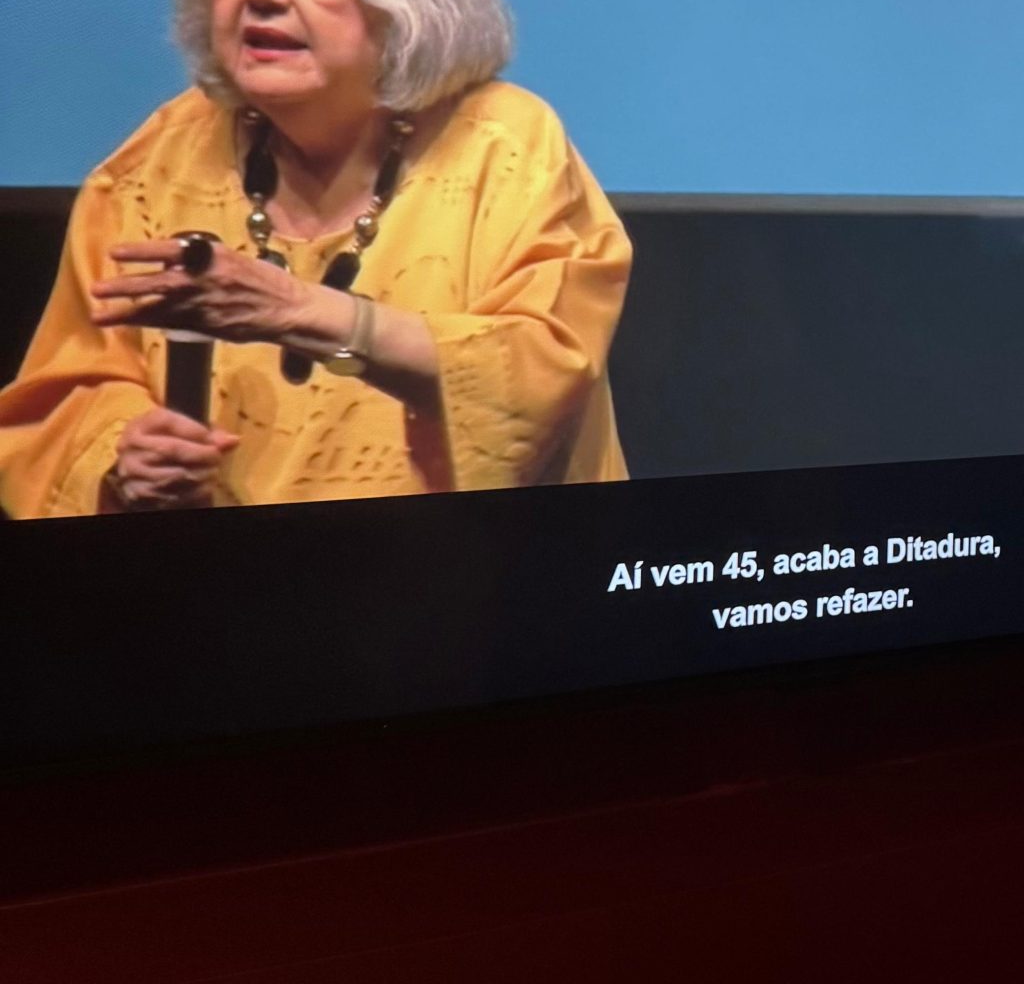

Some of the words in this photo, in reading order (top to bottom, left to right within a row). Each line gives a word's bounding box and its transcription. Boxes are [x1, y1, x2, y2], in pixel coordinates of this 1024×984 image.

[607, 561, 644, 593] Aí
[650, 561, 714, 587] vem
[721, 551, 765, 582] 45,
[772, 543, 856, 575] acaba
[862, 546, 879, 566] a
[886, 532, 1001, 564] Ditadura,
[711, 599, 809, 629] vamos
[816, 587, 914, 618] refazer.
